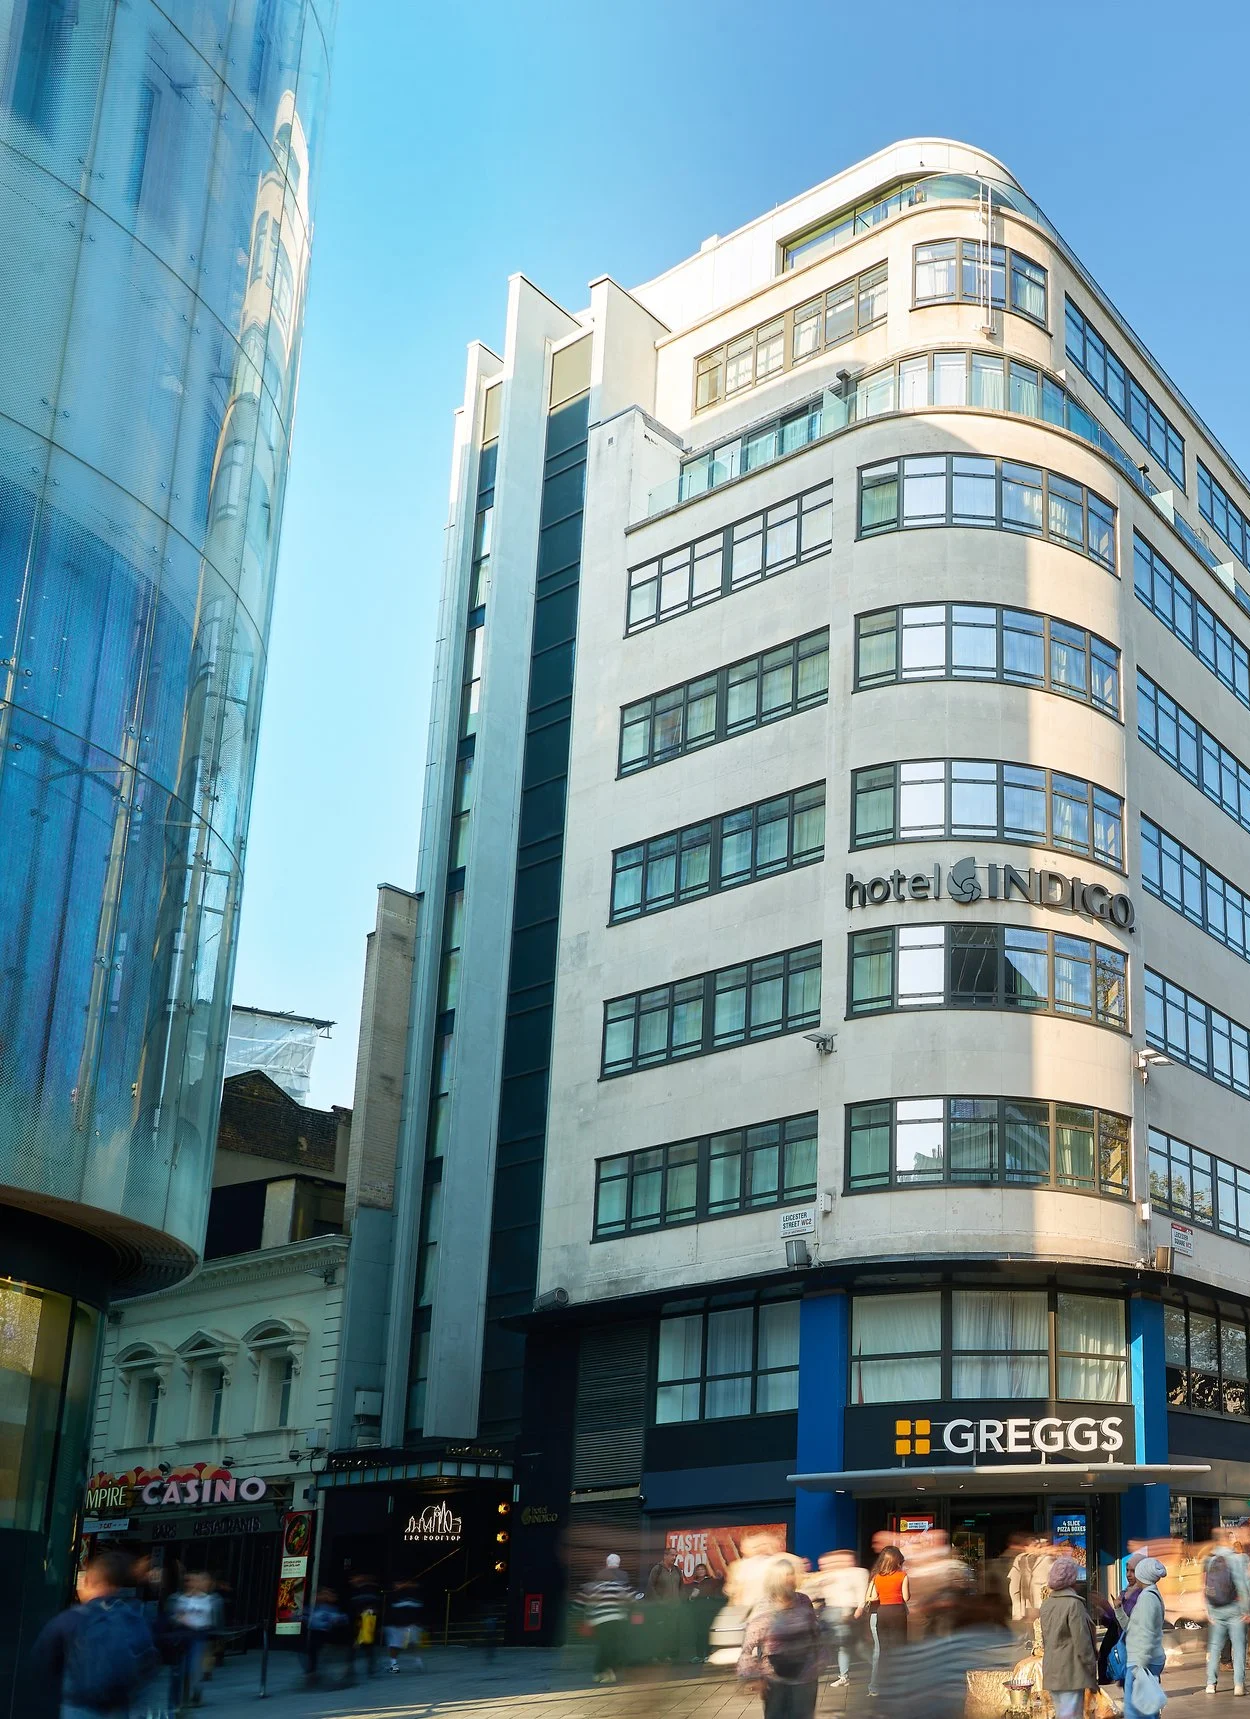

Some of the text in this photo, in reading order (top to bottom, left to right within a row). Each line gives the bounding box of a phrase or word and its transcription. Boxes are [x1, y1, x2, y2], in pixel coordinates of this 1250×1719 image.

[845, 863, 1135, 929] hotel INDIGO
[782, 1212, 808, 1222] LEICESTER
[782, 1218, 812, 1229] STREET WC2
[943, 1417, 1123, 1454] GREGGS
[142, 1477, 267, 1505] CASINO
[670, 1533, 708, 1551] TASTE
